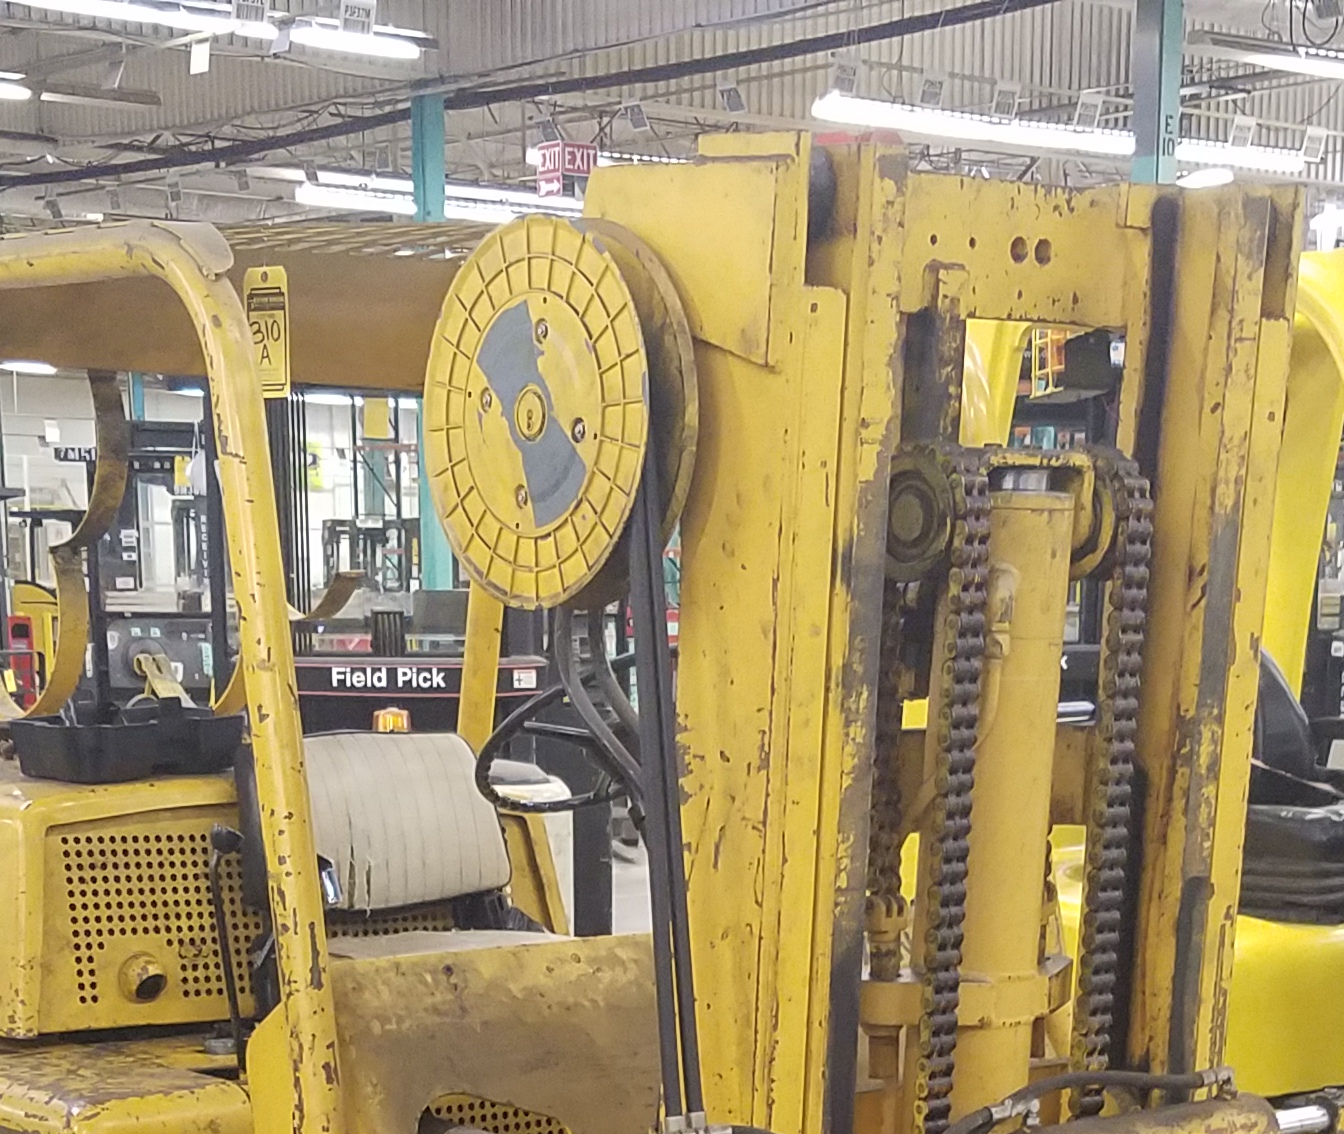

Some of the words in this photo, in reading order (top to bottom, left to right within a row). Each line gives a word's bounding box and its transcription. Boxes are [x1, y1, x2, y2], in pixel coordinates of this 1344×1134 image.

[1165, 114, 1174, 135] E
[538, 146, 560, 172] EXIT
[565, 147, 596, 171] EXIT
[249, 319, 282, 345] 310
[259, 343, 273, 366] A
[58, 447, 96, 461] 7M51
[331, 667, 387, 688] Field
[397, 666, 446, 688] Pick
